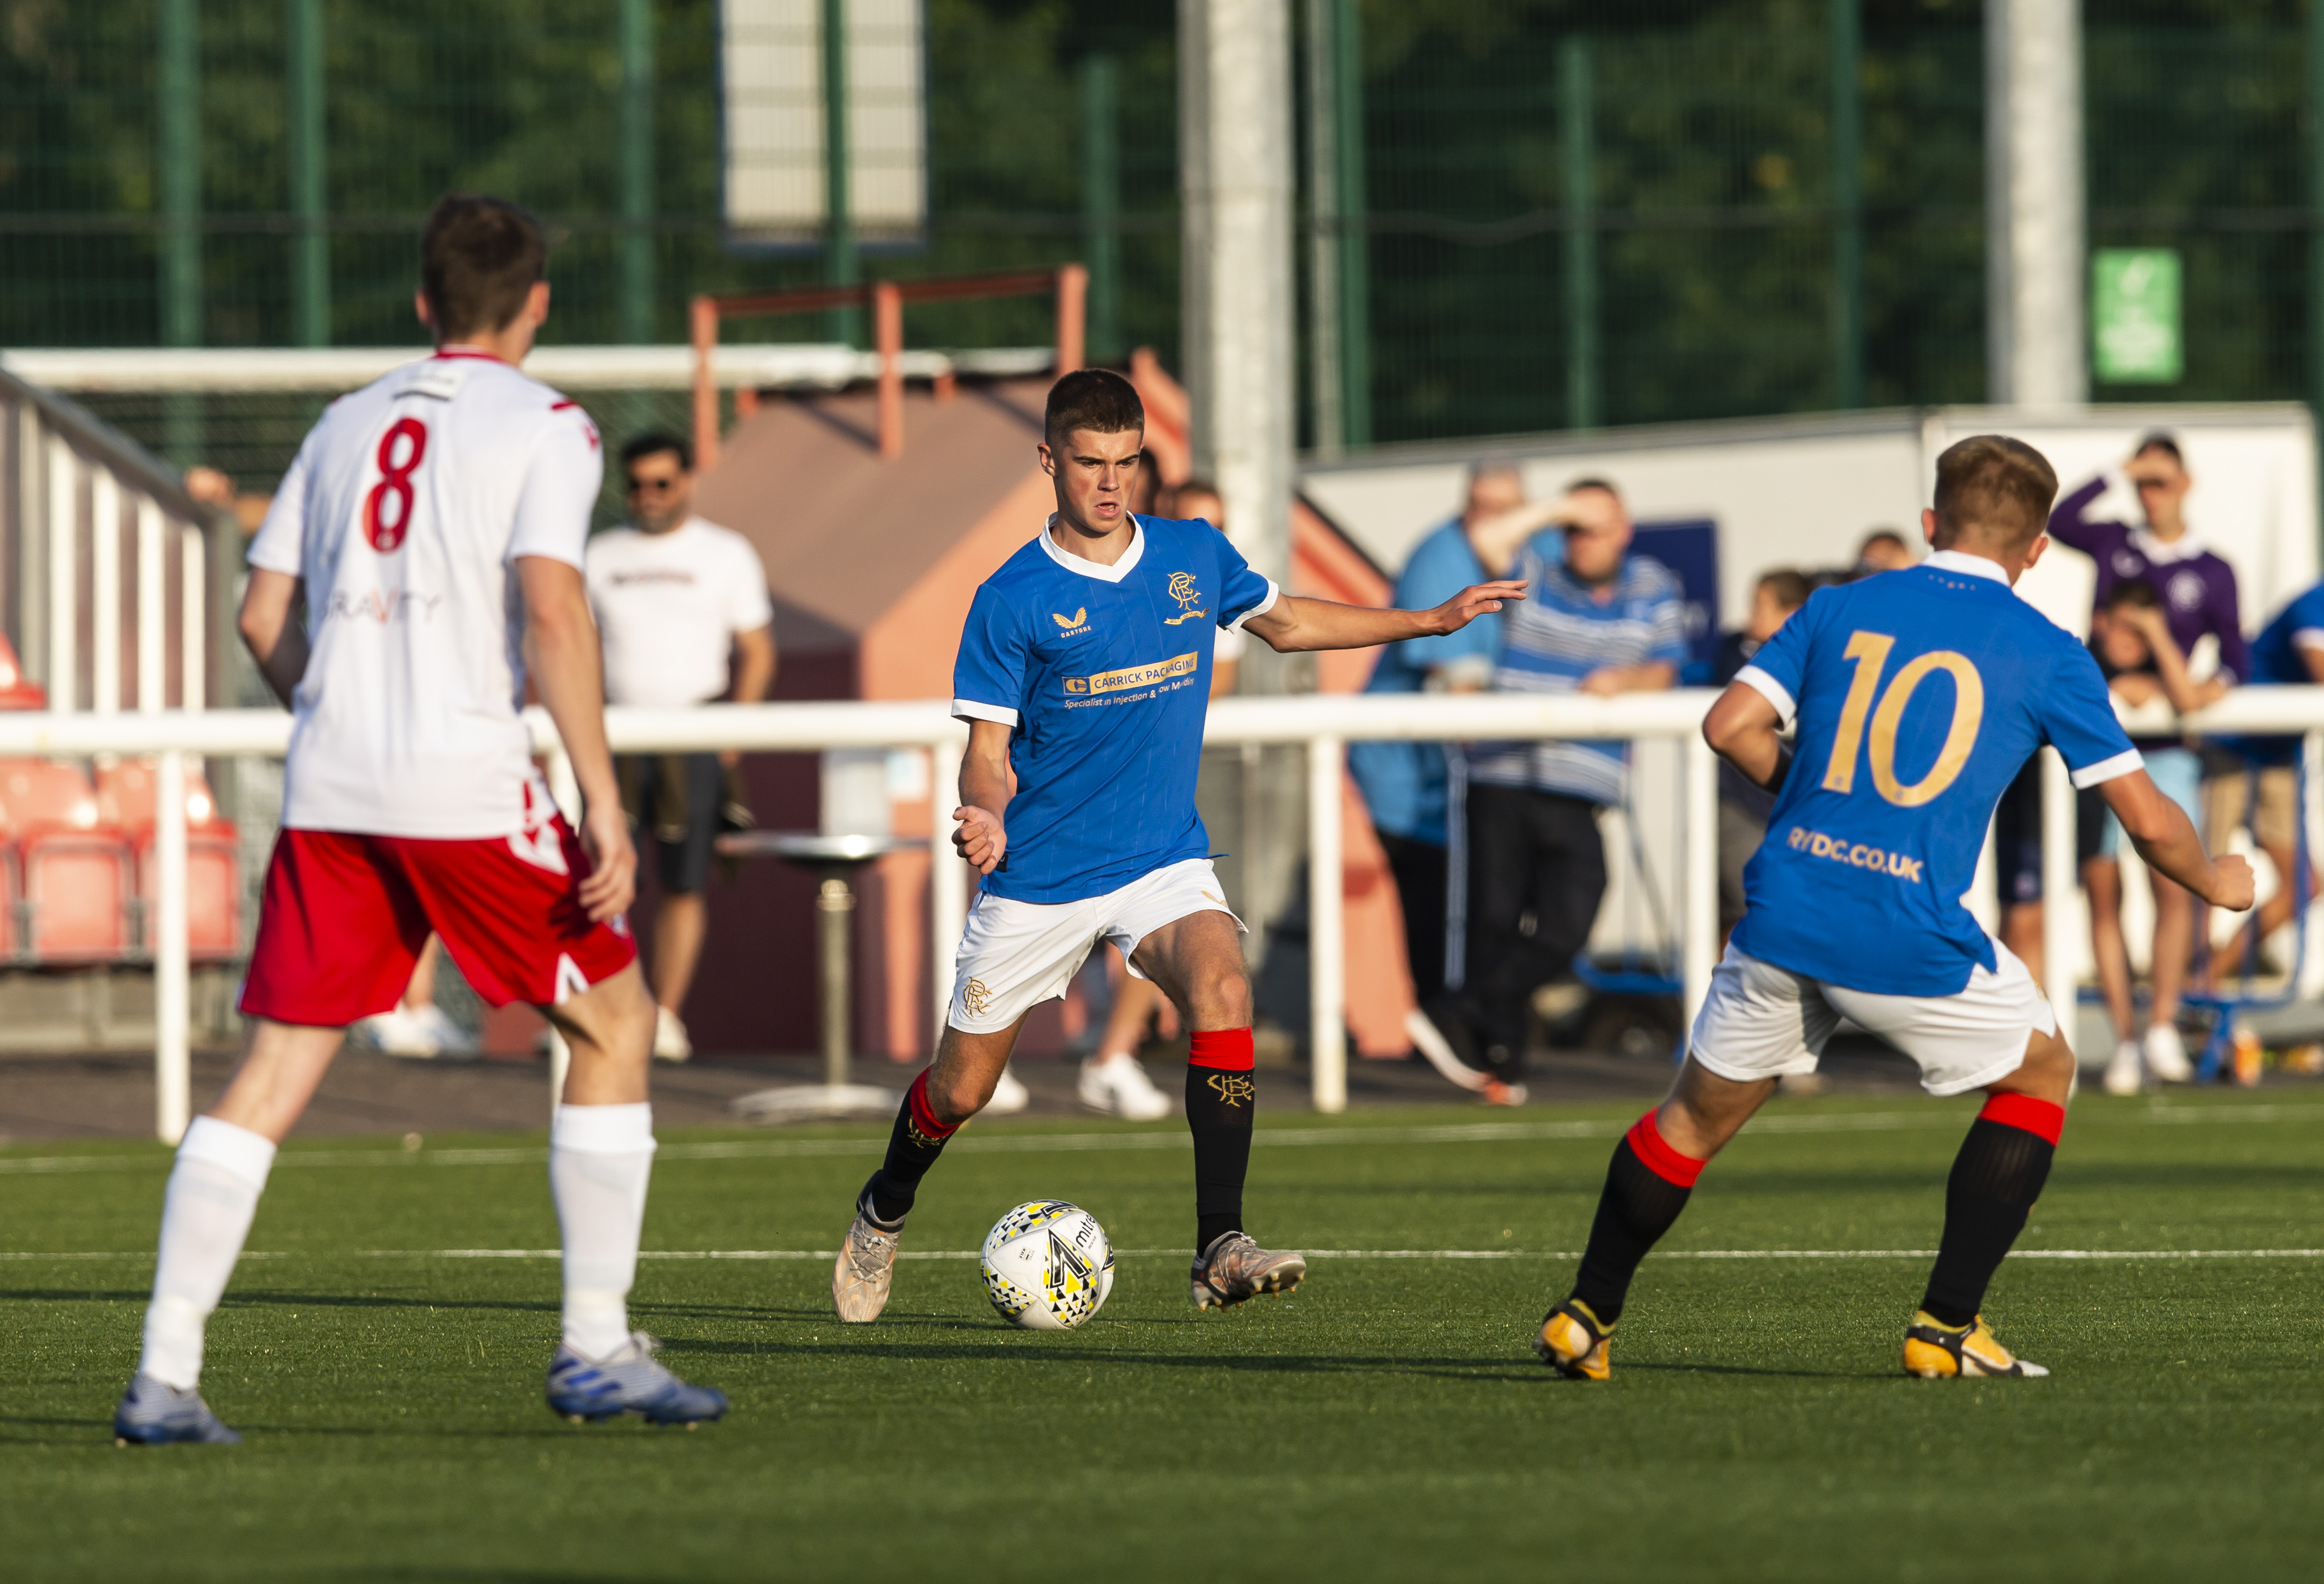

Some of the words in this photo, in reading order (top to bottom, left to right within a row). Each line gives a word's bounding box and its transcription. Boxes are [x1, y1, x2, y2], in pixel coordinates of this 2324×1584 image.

[362, 416, 428, 555] 8
[1094, 672, 1144, 689] CARRICK
[1145, 658, 1194, 680] PACKAGING
[1064, 698, 1103, 709] Specialist
[1113, 693, 1147, 705] Injection
[1149, 689, 1156, 698] &
[1822, 630, 1985, 807] 10
[1786, 825, 1925, 884] RYDC.CO.UK
[1075, 1214, 1096, 1248] mitre
